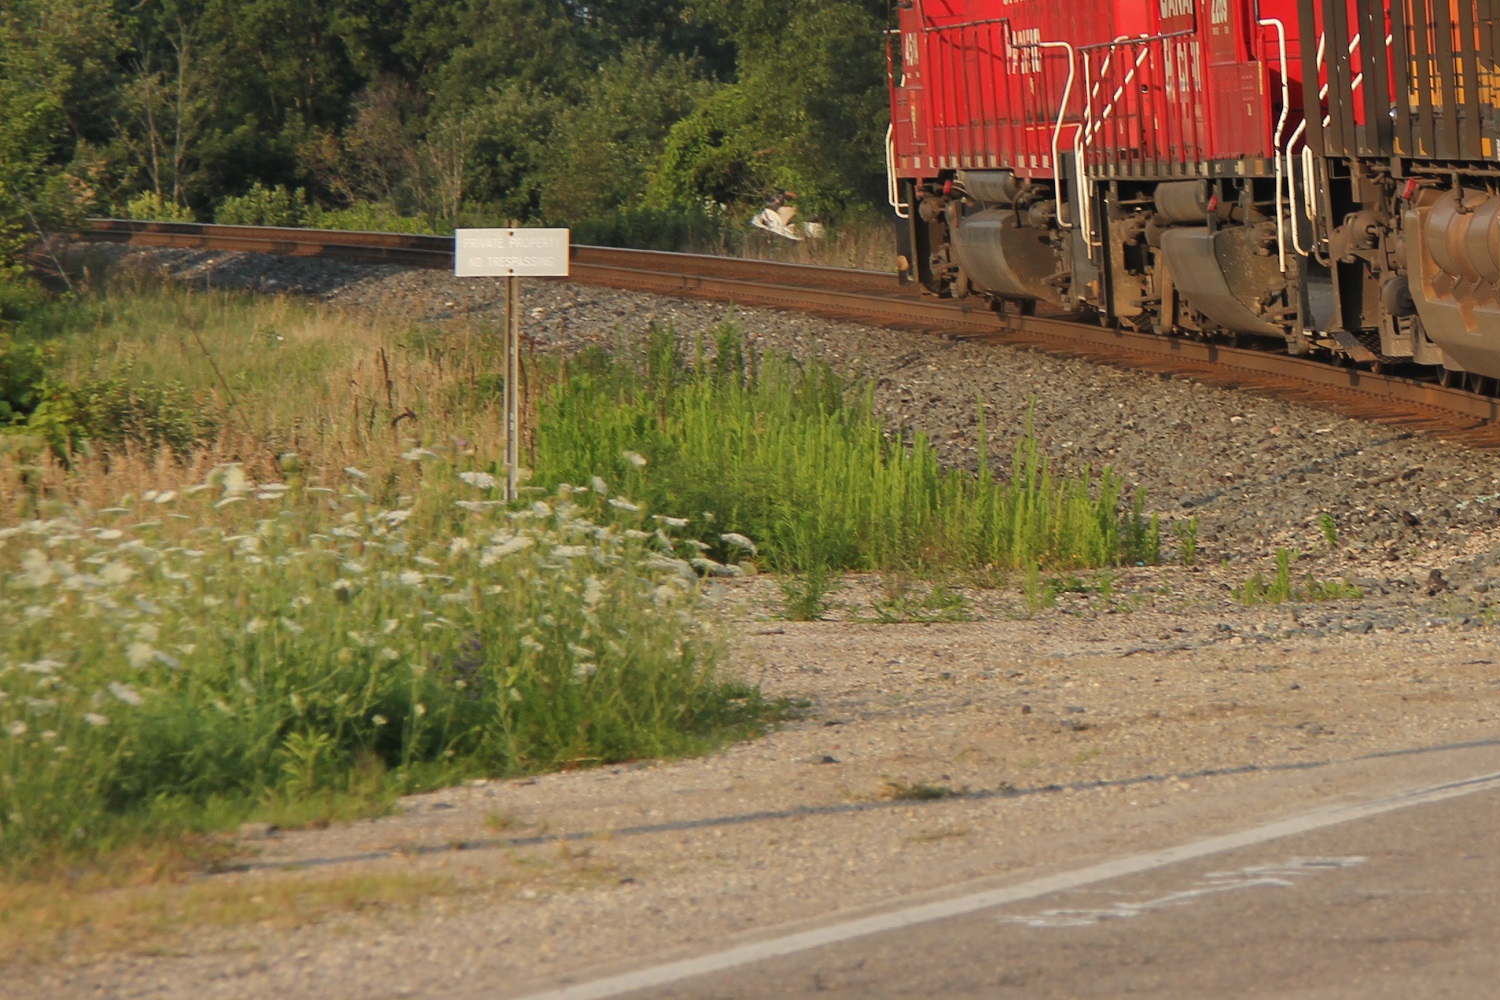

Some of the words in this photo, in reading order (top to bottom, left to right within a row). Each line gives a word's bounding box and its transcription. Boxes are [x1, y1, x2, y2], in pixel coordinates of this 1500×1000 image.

[463, 238, 504, 249] PRIVATE
[509, 238, 561, 249] PROPERTY
[468, 256, 483, 267] NO
[487, 256, 554, 267] TRESPASSING
